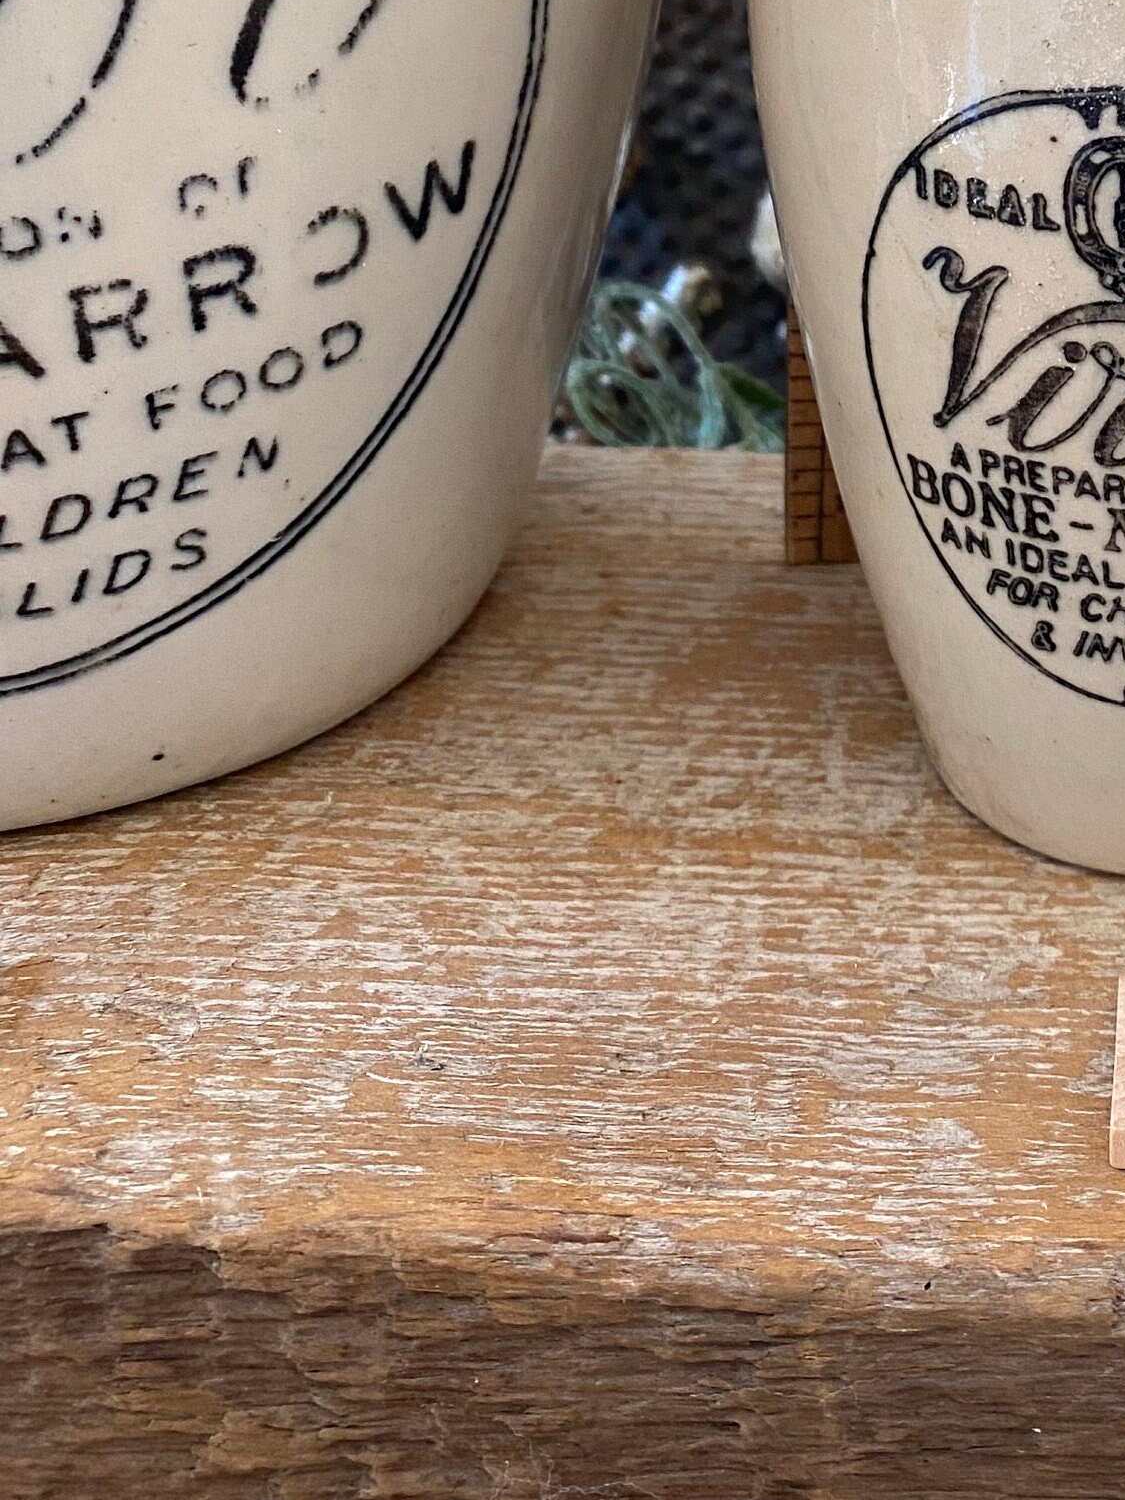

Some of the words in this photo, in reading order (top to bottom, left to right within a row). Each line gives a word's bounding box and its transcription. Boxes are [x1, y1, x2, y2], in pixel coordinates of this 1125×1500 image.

[914, 158, 1061, 232] IDEAL
[145, 320, 364, 431] FOOD
[950, 442, 972, 474] A
[941, 518, 992, 560] AN
[1005, 538, 1125, 590] IDEAL
[985, 566, 1059, 612] FOR
[1030, 620, 1057, 653] &
